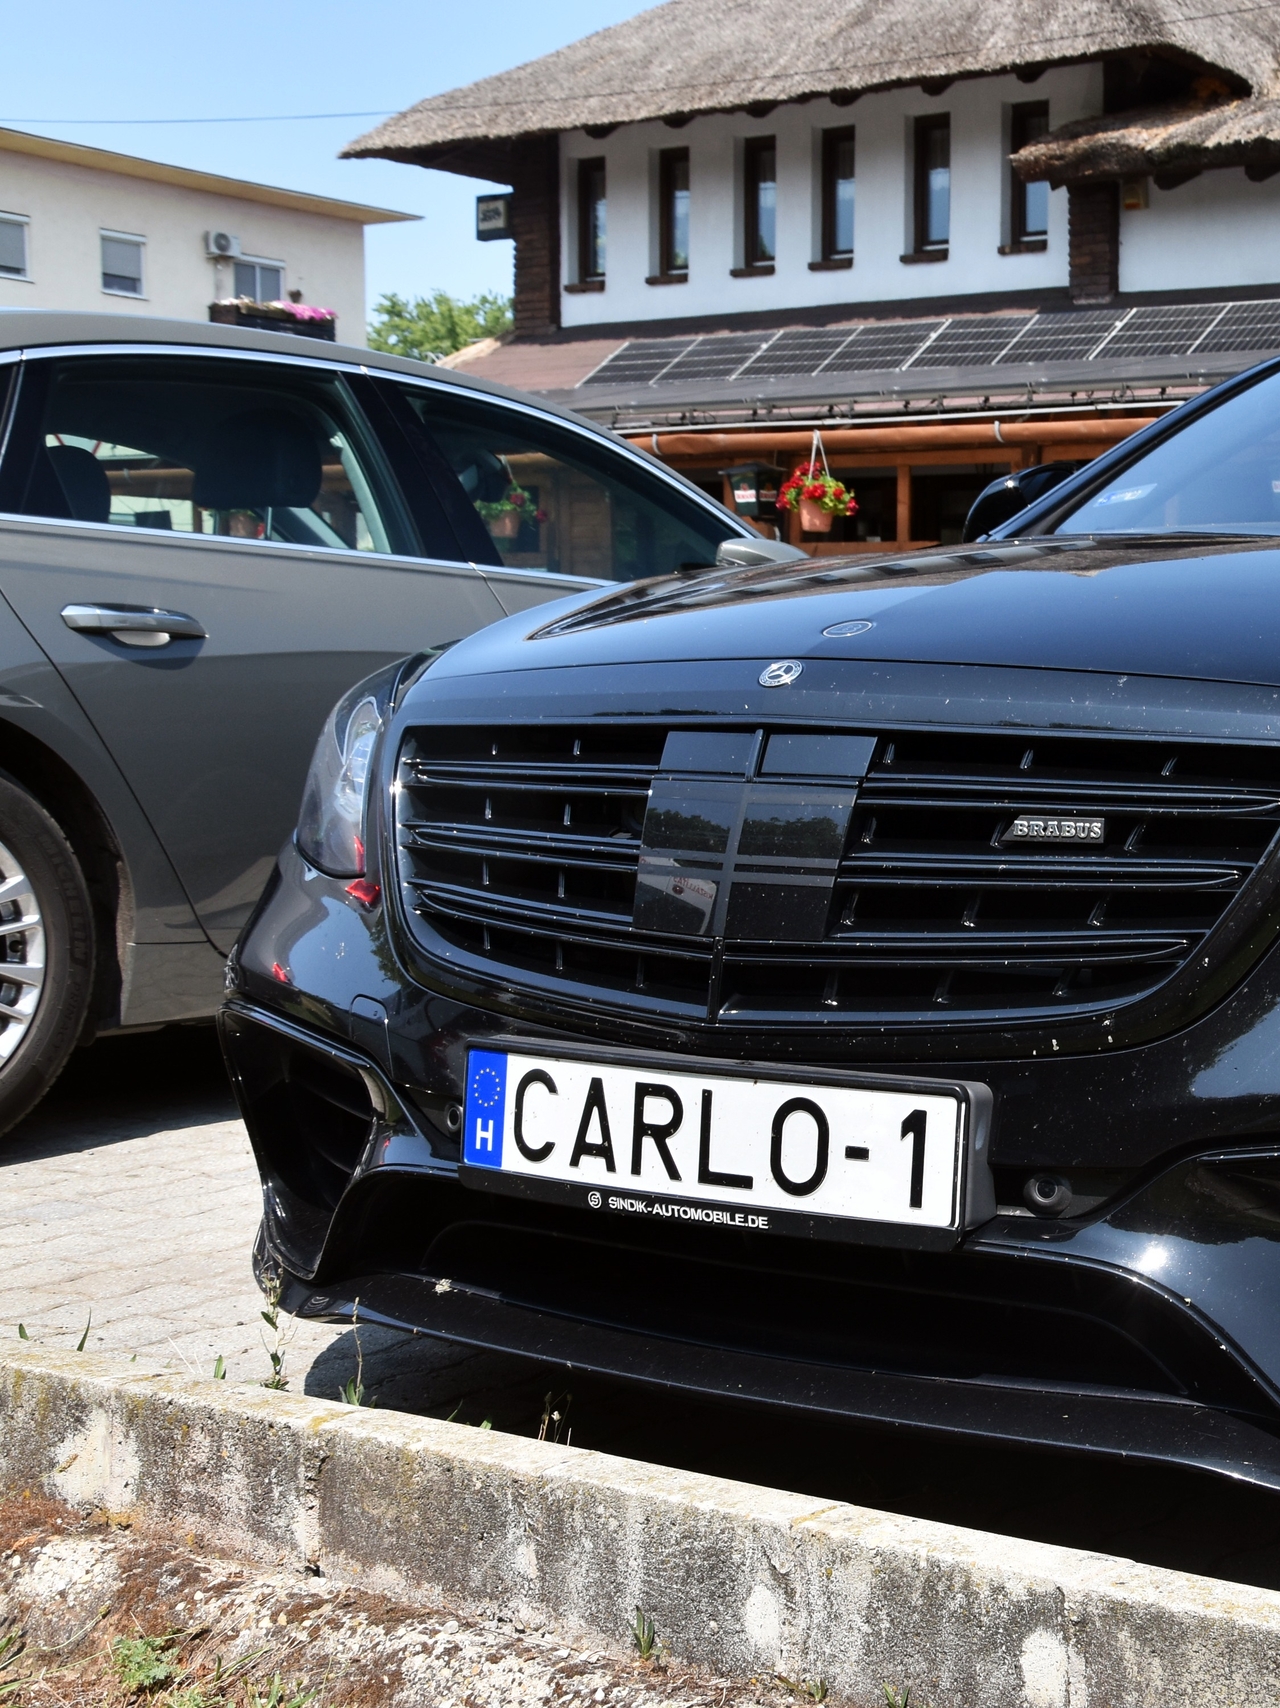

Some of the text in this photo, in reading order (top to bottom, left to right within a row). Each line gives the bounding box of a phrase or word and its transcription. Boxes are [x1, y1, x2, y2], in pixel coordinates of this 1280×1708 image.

[1013, 820, 1102, 839] BRABUS
[42, 838, 87, 962] MICHELIN
[475, 1117, 494, 1152] H
[513, 1068, 929, 1209] CARLO-1
[608, 1196, 769, 1229] SINDIK-AUTOMOBILE.DE
